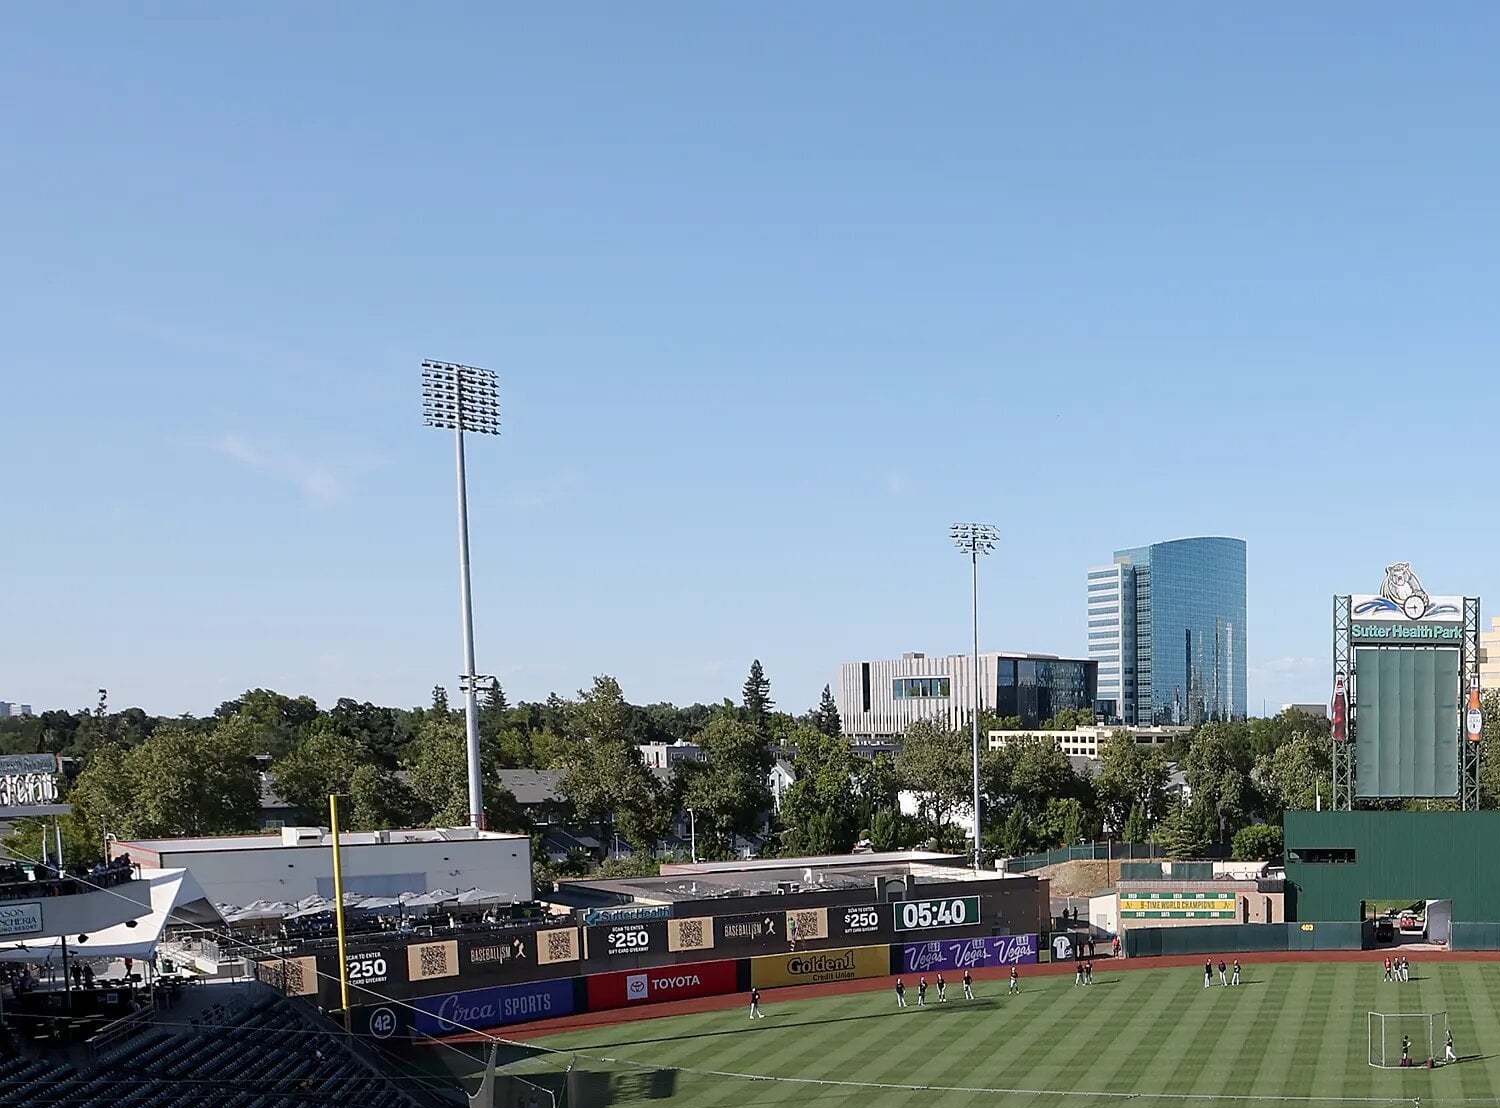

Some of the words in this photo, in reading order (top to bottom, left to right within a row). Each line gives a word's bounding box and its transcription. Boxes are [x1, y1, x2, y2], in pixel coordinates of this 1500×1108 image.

[1352, 624, 1391, 638] Sutter
[1392, 624, 1433, 638] Health
[1434, 625, 1463, 639] Park
[601, 910, 636, 921] Sutter
[636, 906, 670, 919] Health
[1161, 901, 1180, 910] WORLD
[1181, 901, 1215, 910] CHAMPIONS
[844, 911, 878, 928] $250
[902, 900, 966, 929] 05:40
[607, 930, 649, 948] $250
[365, 951, 381, 959] ENTER
[470, 944, 511, 965] BASEBALLISM
[905, 944, 947, 971] Vegas
[949, 941, 992, 967] Vegas
[993, 938, 1036, 964] Vegas
[652, 975, 700, 990] TOYOTA
[812, 973, 834, 982] Credit
[835, 971, 855, 980] Union
[438, 995, 496, 1031] Circa
[505, 993, 551, 1016] SPORTS
[374, 1014, 392, 1031] 42
